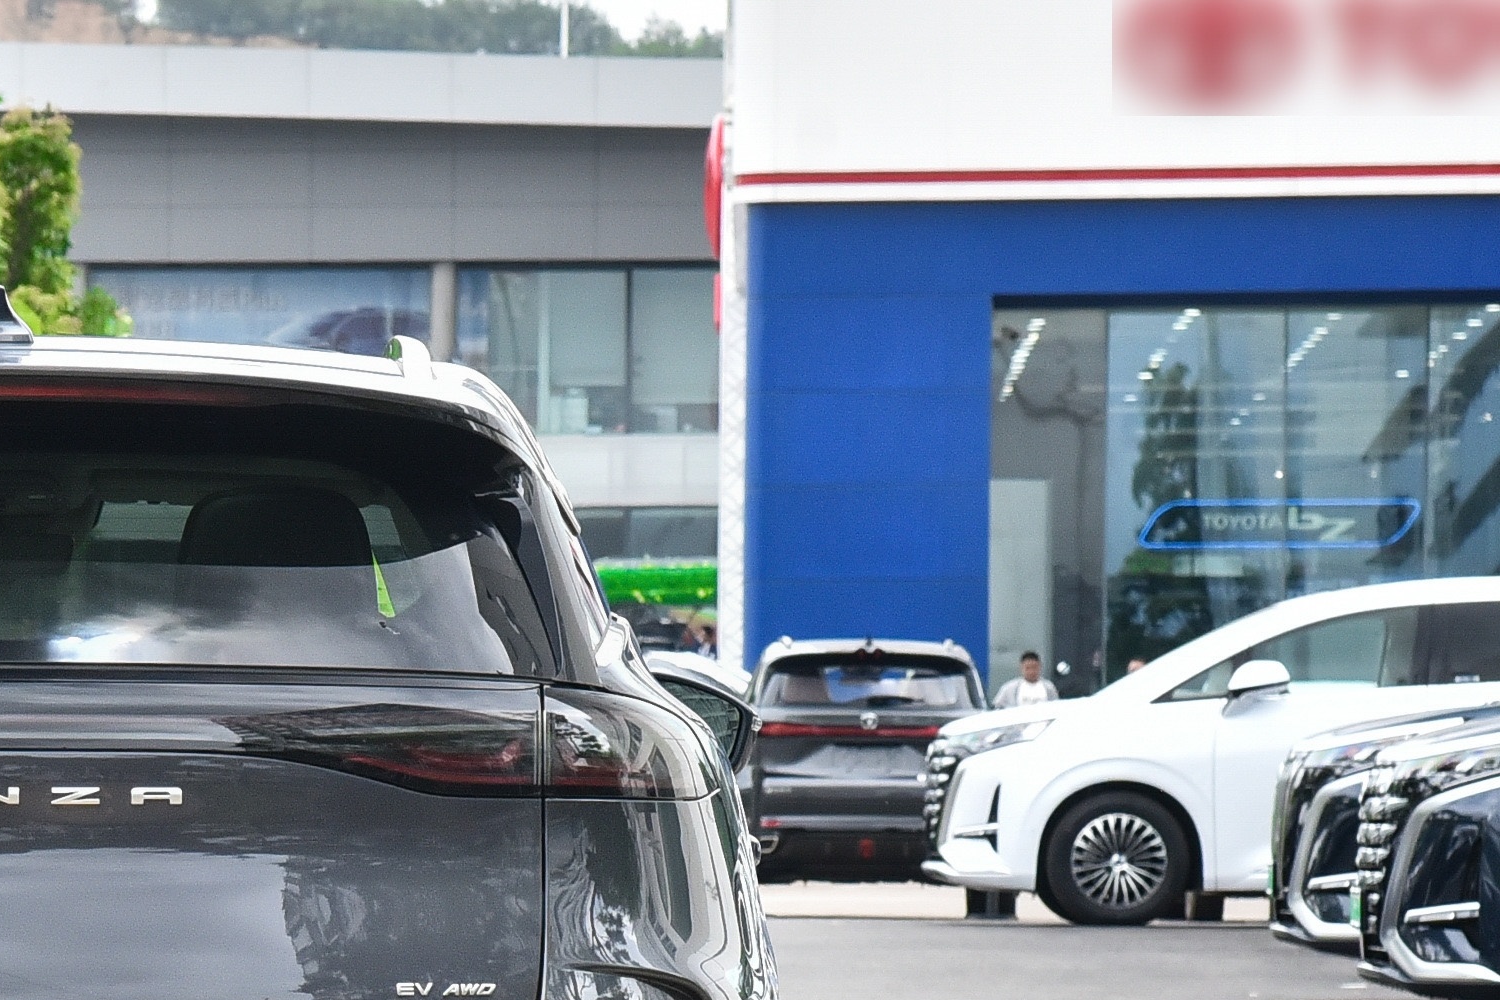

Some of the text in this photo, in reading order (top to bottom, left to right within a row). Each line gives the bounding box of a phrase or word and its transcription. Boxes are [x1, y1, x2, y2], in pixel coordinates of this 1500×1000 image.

[1203, 513, 1283, 531] TOYOTA
[396, 981, 497, 997] EV AWD
